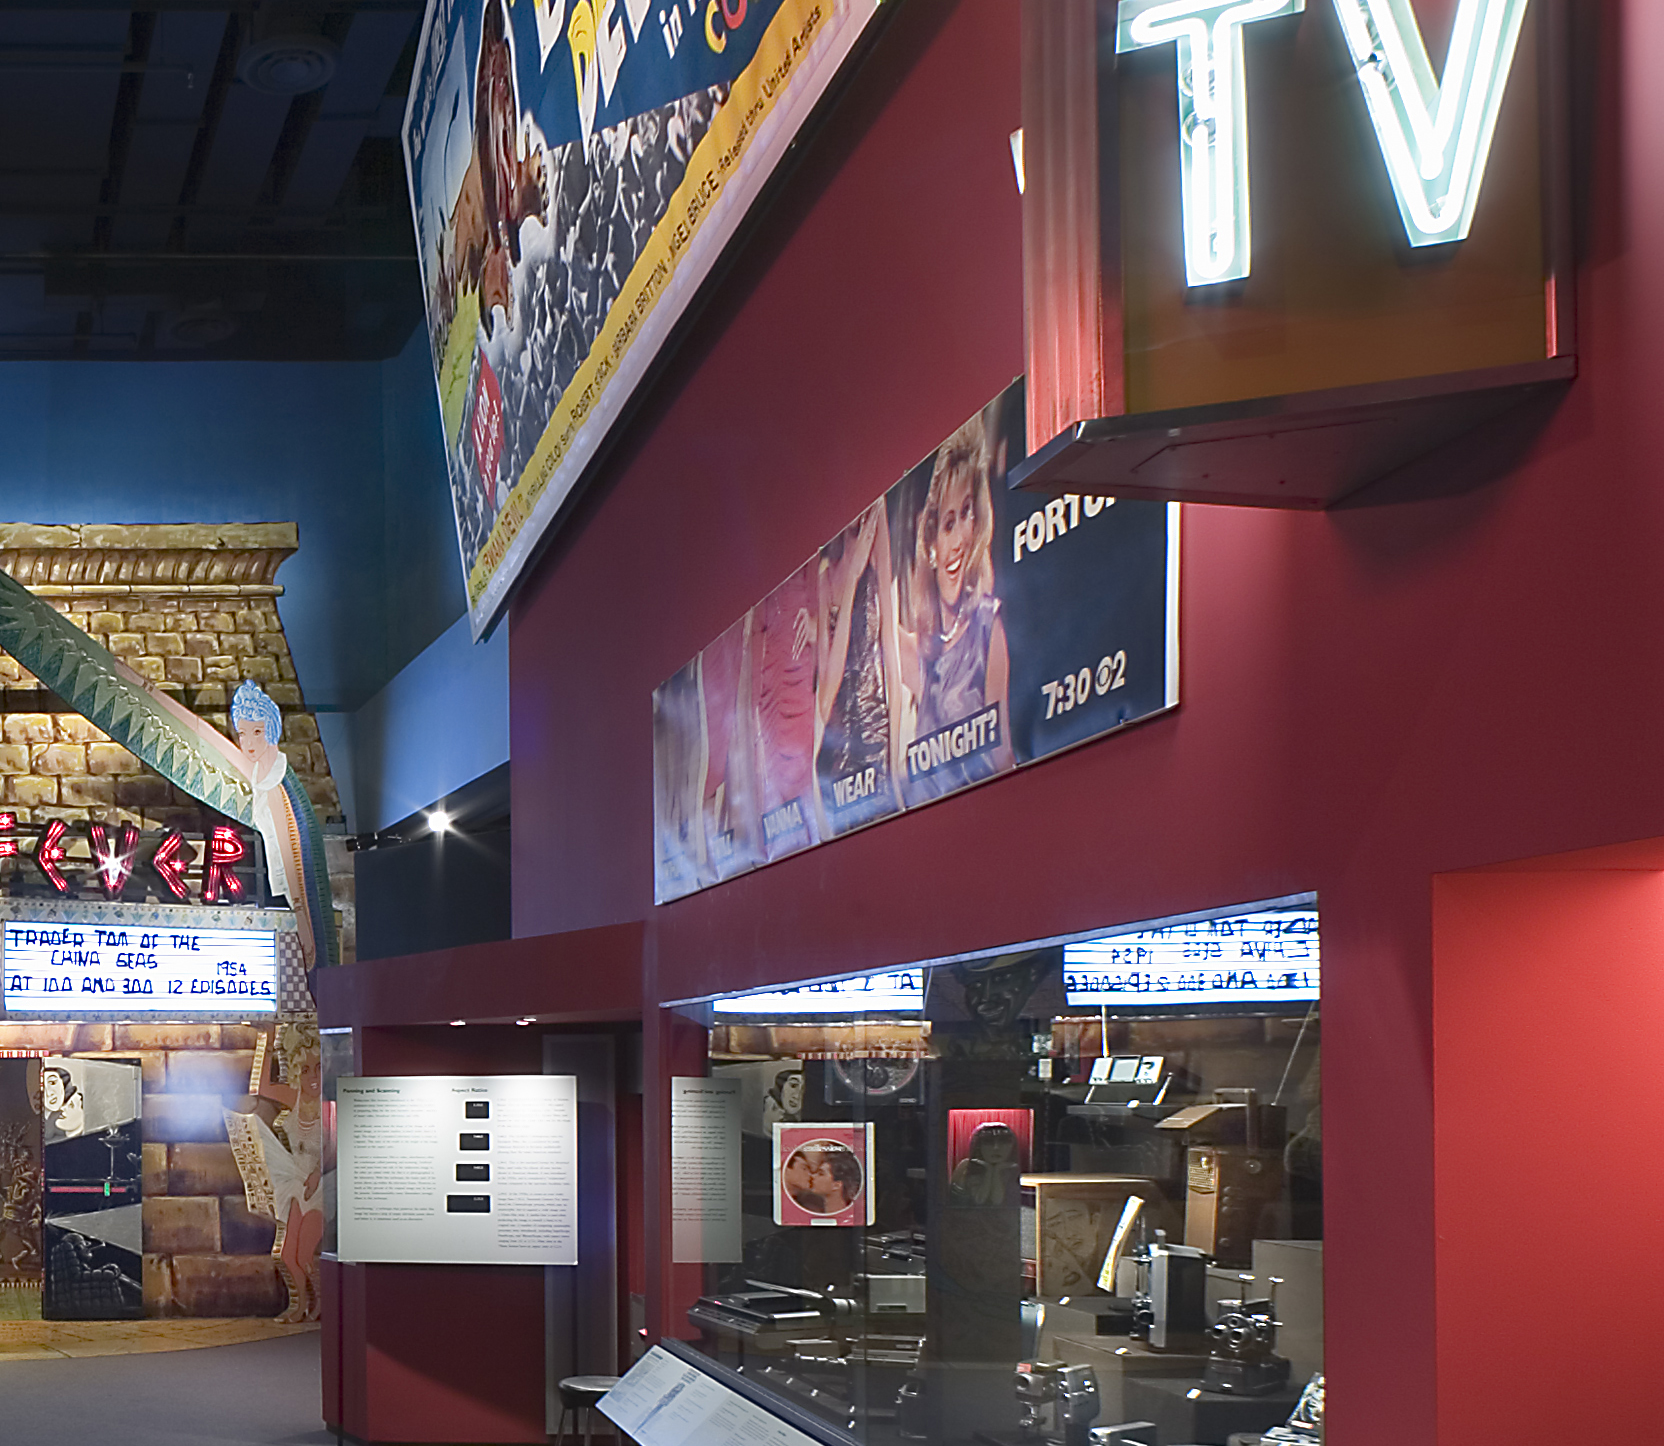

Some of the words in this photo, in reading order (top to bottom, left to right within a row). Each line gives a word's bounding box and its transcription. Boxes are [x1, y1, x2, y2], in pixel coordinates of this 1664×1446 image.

[660, 9, 685, 57] in
[687, 170, 720, 228] BRUCE
[761, 56, 792, 97] United
[791, 6, 822, 57] Artists
[1041, 667, 1091, 719] 7:30
[833, 768, 876, 808] WEAR
[908, 709, 997, 772] TONIGHT?
[10, 929, 84, 947] TRADER
[95, 930, 129, 948] TOM
[140, 934, 159, 949] OF
[170, 934, 201, 952] THE
[51, 950, 101, 967] CHINA
[116, 953, 158, 969] SEAS
[217, 961, 247, 977] 1954
[10, 976, 33, 991] AT
[43, 978, 73, 992] 100
[82, 977, 115, 994] AND
[122, 978, 153, 994] 300
[168, 980, 183, 994] 12
